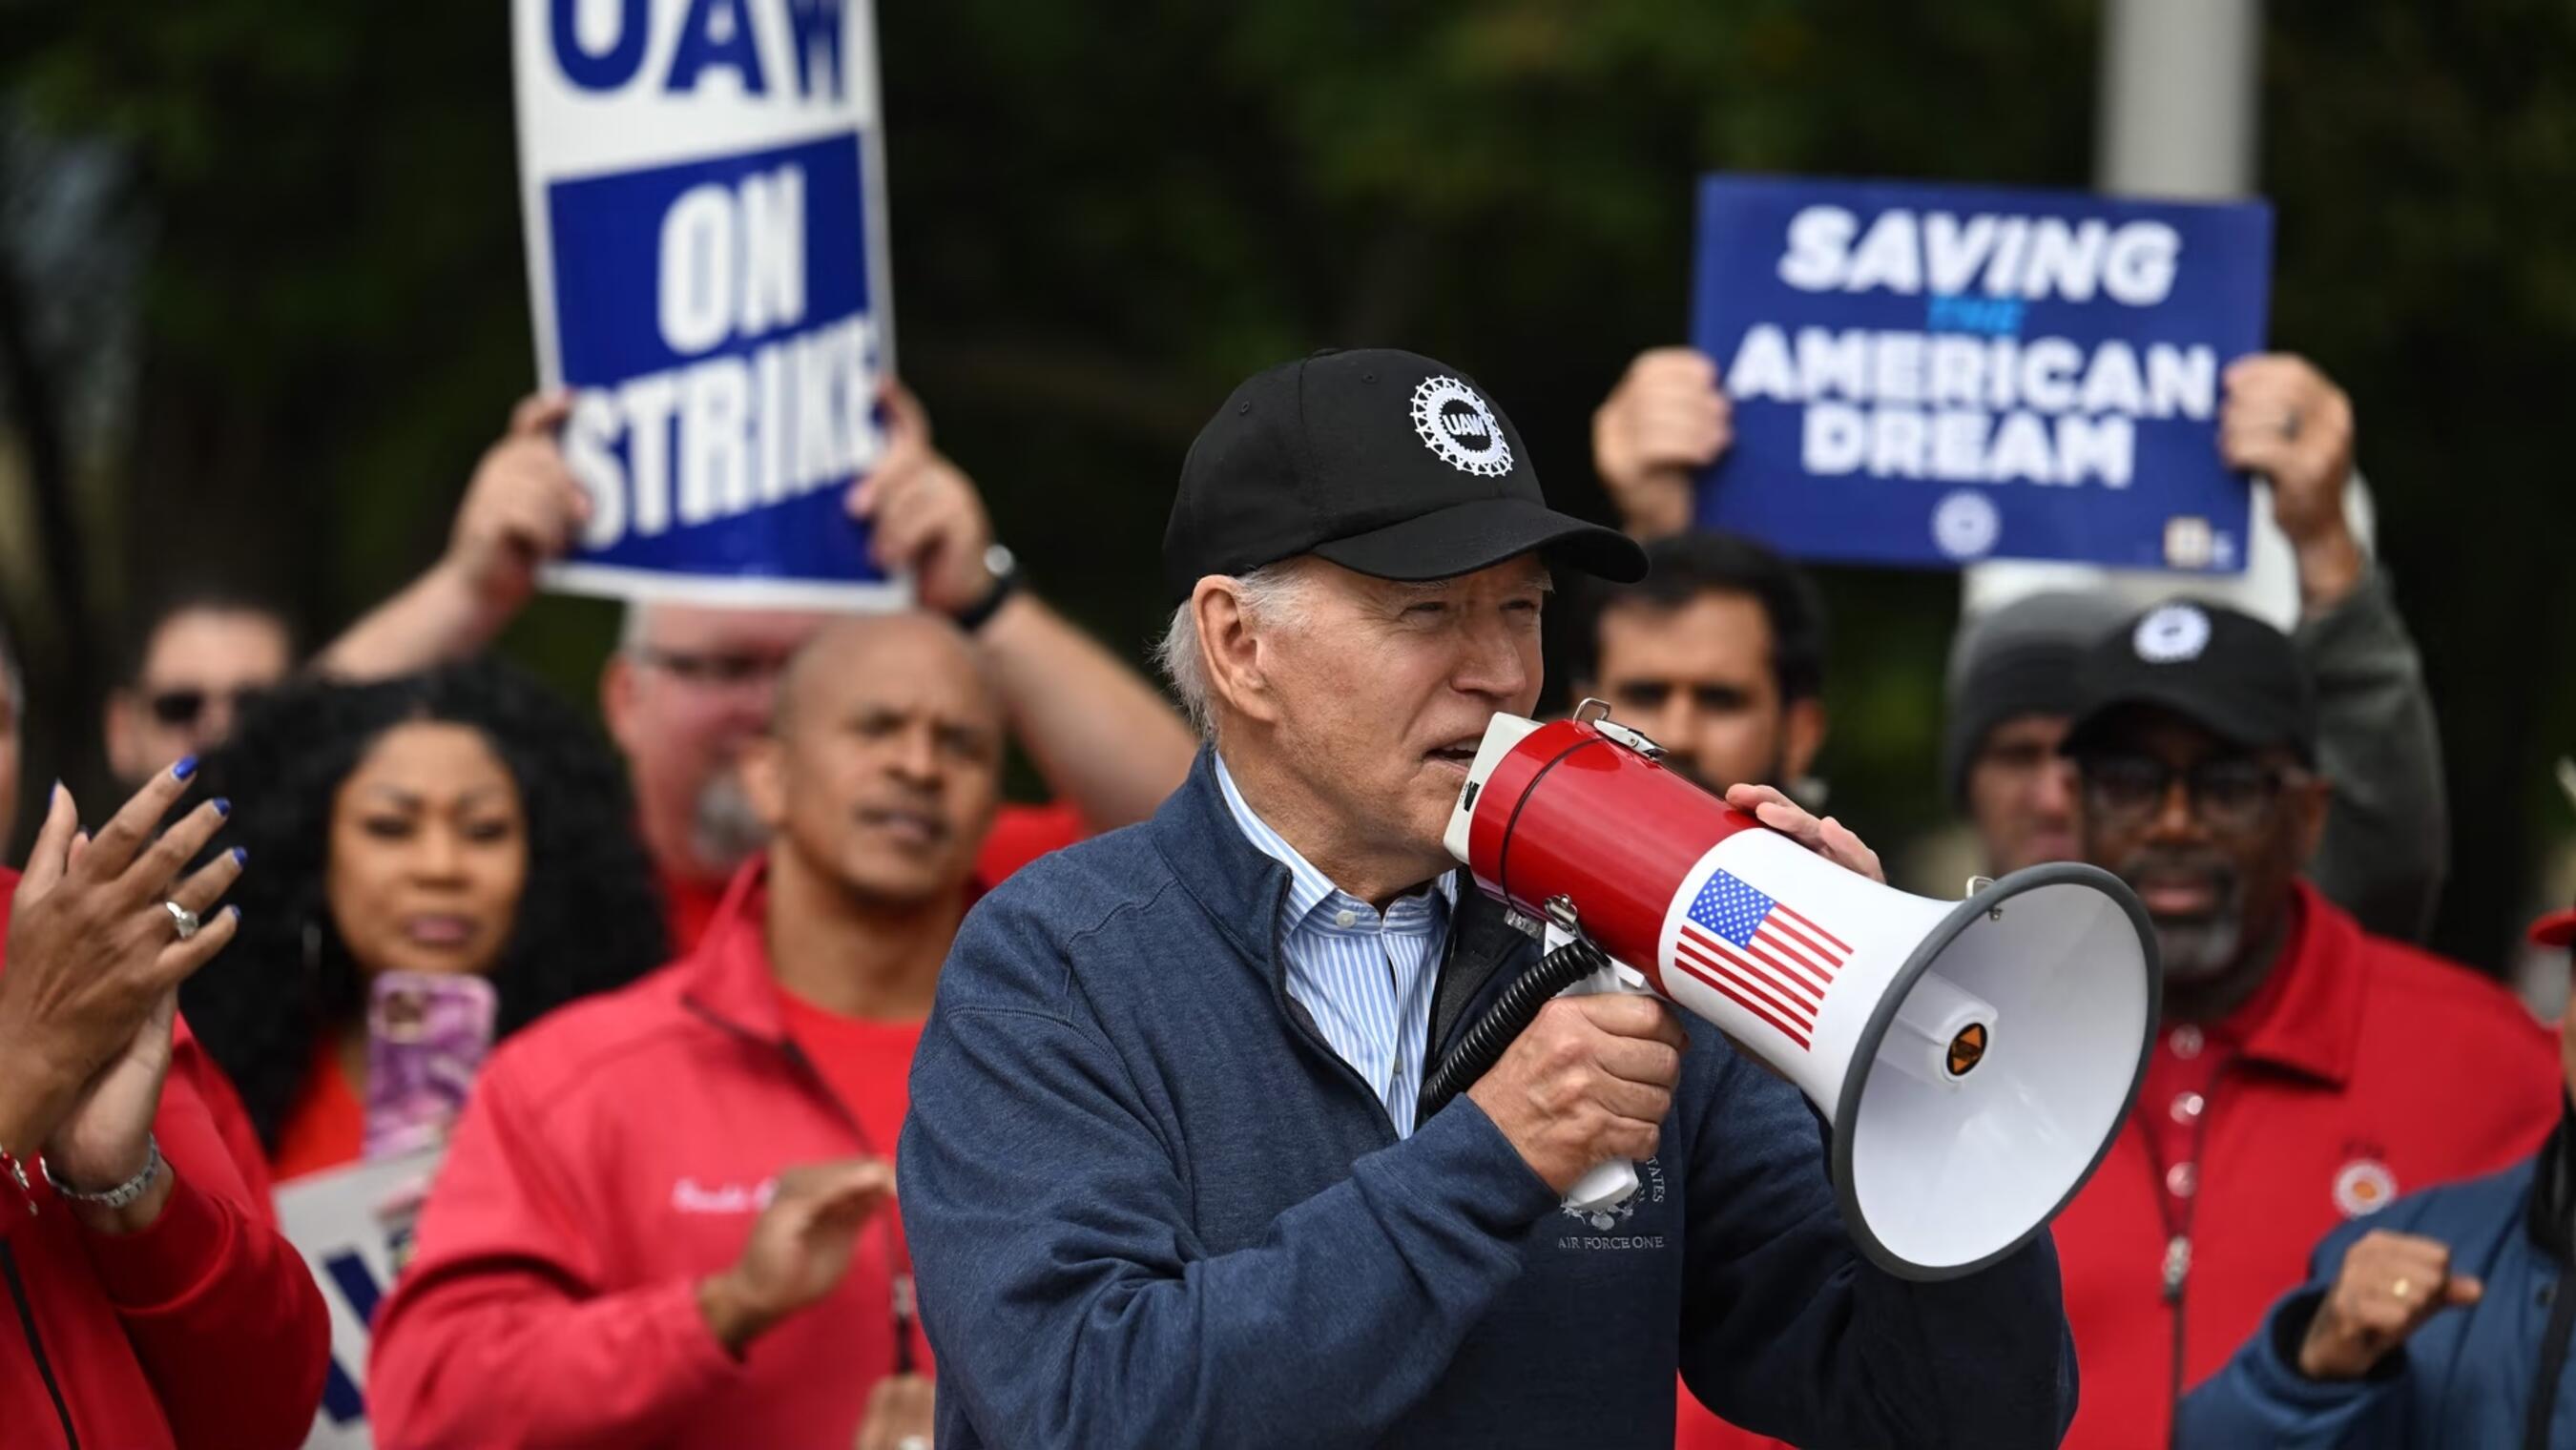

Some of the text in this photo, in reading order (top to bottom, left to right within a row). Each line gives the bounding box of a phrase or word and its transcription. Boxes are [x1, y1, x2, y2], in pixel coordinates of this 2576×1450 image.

[551, 0, 848, 99] UAW
[658, 165, 804, 354] ON
[1779, 205, 2181, 305] SAVING
[1728, 324, 2216, 419] AMERICAN
[563, 313, 885, 550] STRIKE
[1442, 413, 1487, 436] UAW
[1802, 404, 2135, 487] DREAM
[1646, 1155, 1665, 1203] TATES
[1558, 1236, 1664, 1250] AIR FORCE ONE
